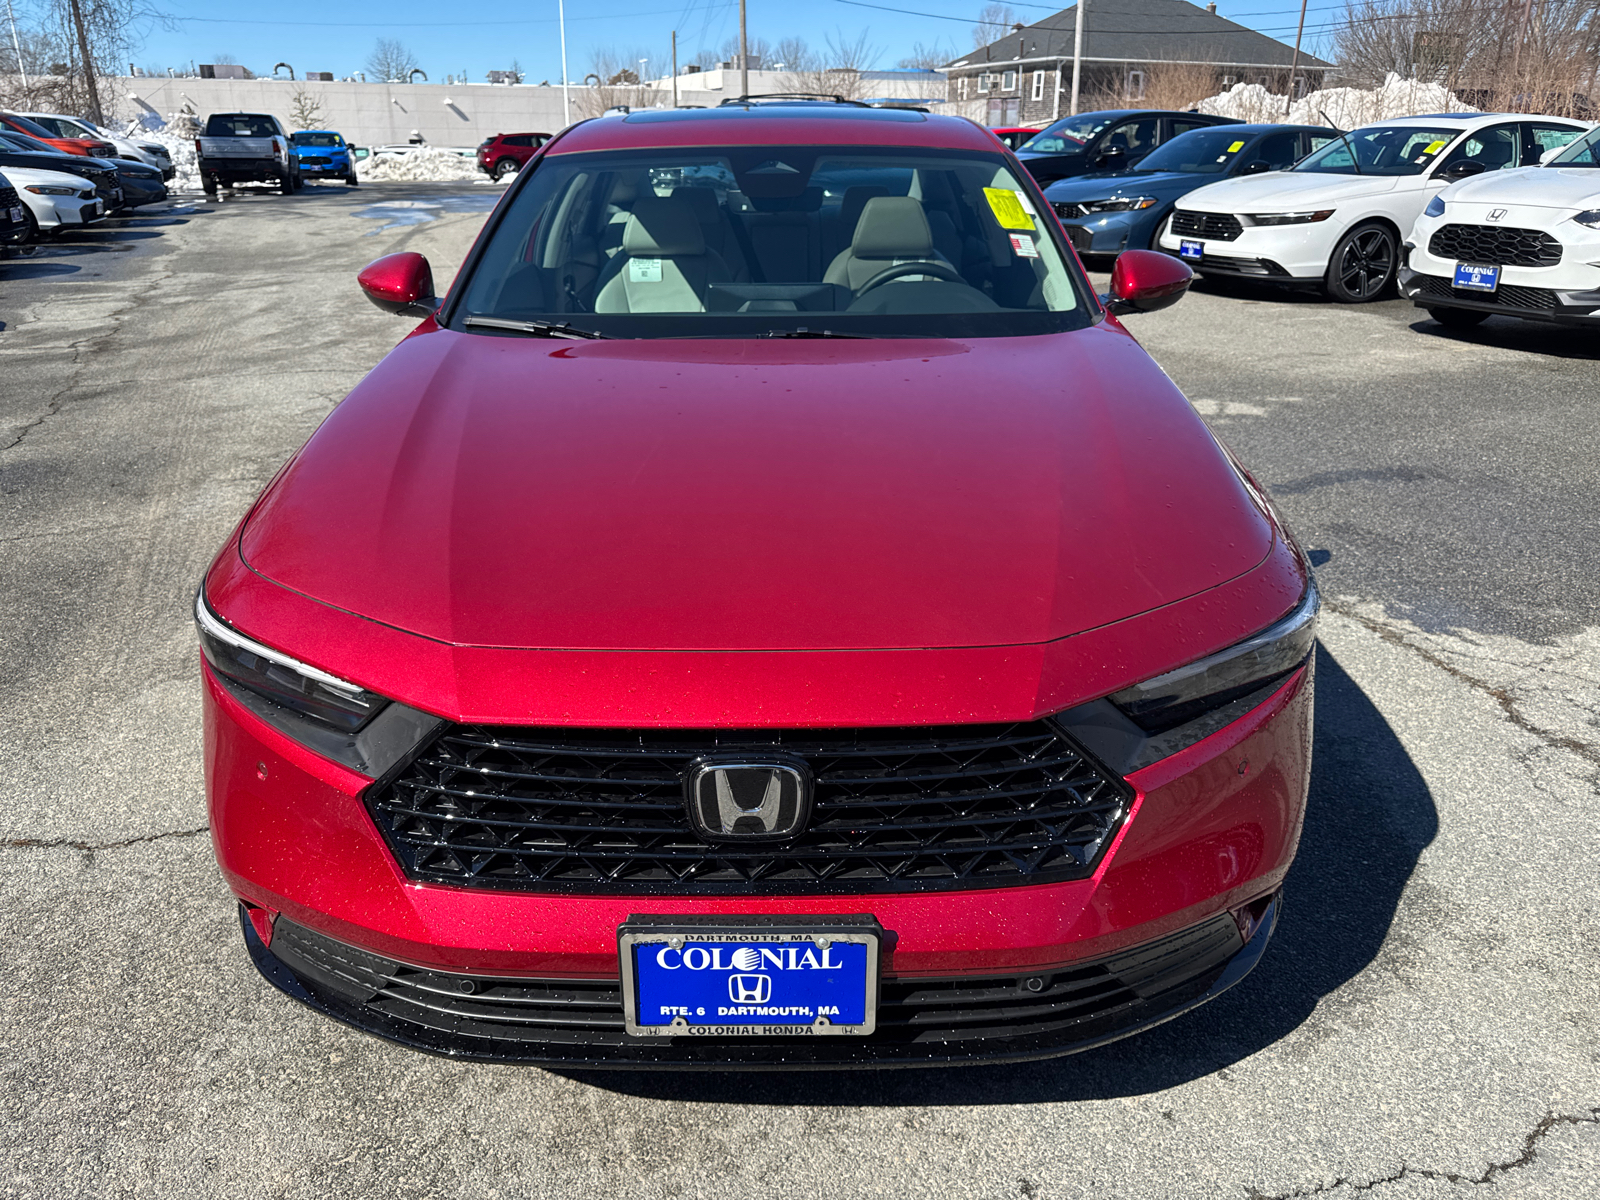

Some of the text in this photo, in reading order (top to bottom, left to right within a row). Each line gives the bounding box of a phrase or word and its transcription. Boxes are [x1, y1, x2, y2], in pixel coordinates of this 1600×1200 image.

[656, 947, 843, 971] COLONIAL
[660, 1006, 840, 1017] RTE. 6 DARTMOUTH, MA
[688, 1026, 814, 1035] COLONIAL HONDA
